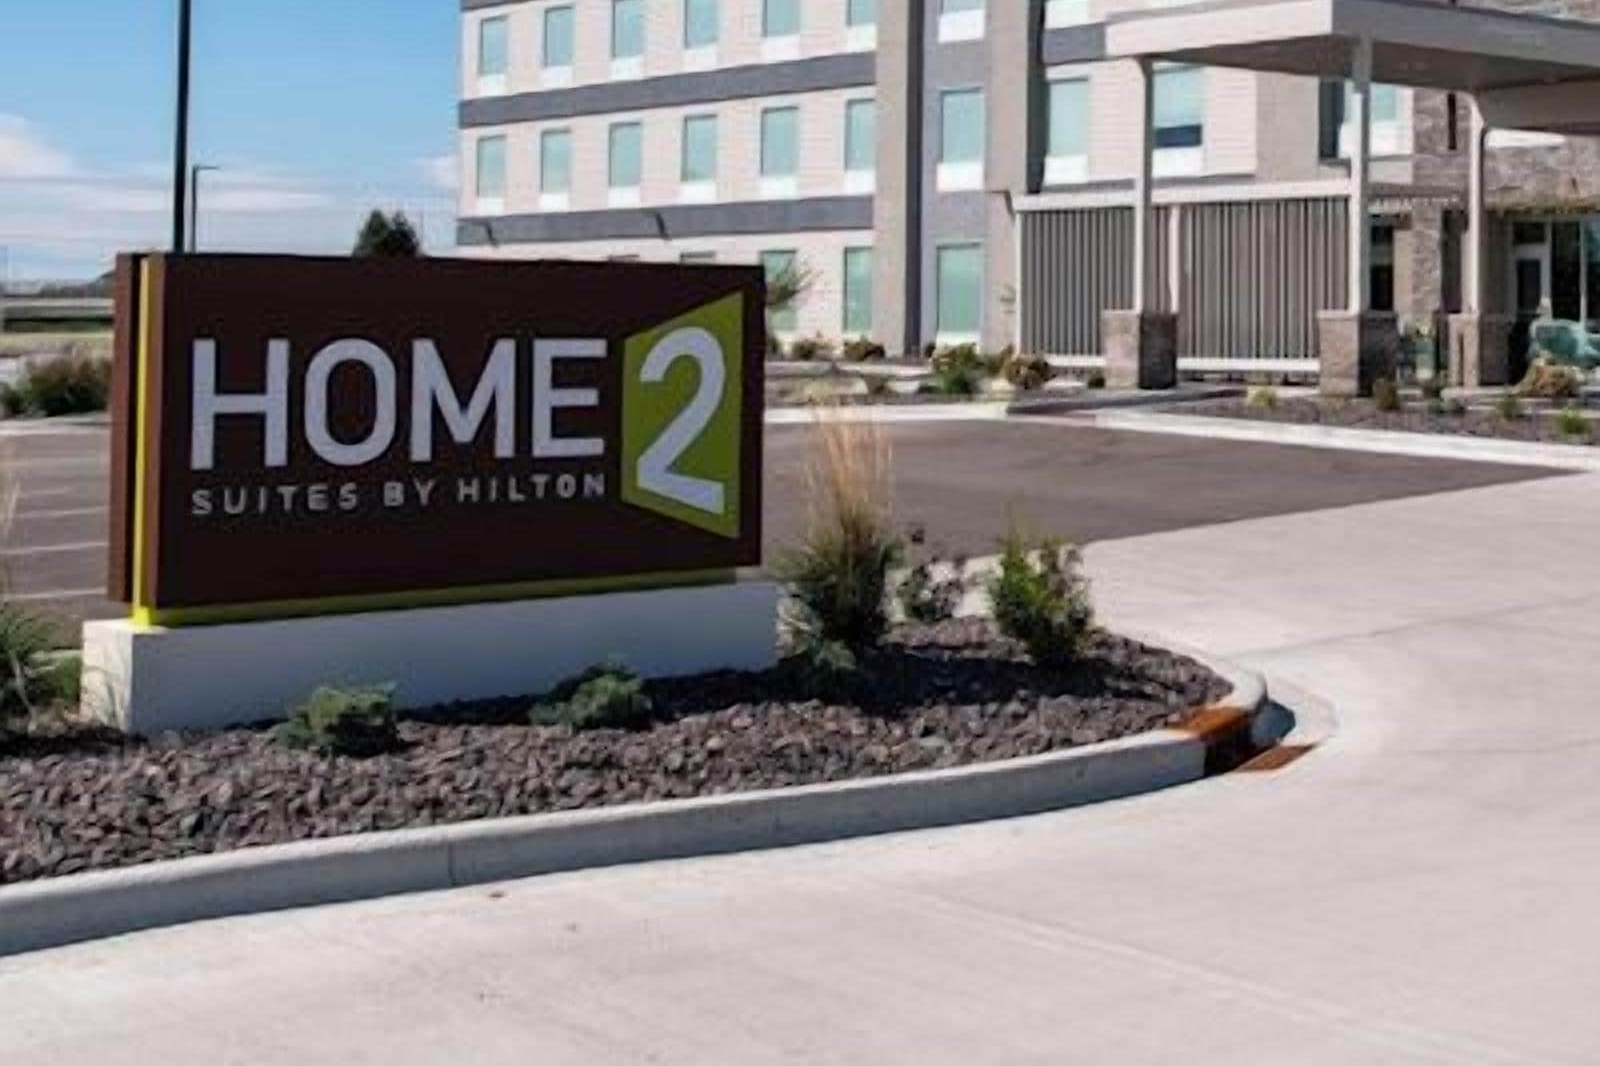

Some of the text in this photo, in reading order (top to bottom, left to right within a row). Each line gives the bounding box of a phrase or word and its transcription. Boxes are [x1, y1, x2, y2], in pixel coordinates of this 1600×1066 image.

[191, 472, 605, 515] SUITES BY HILTON
